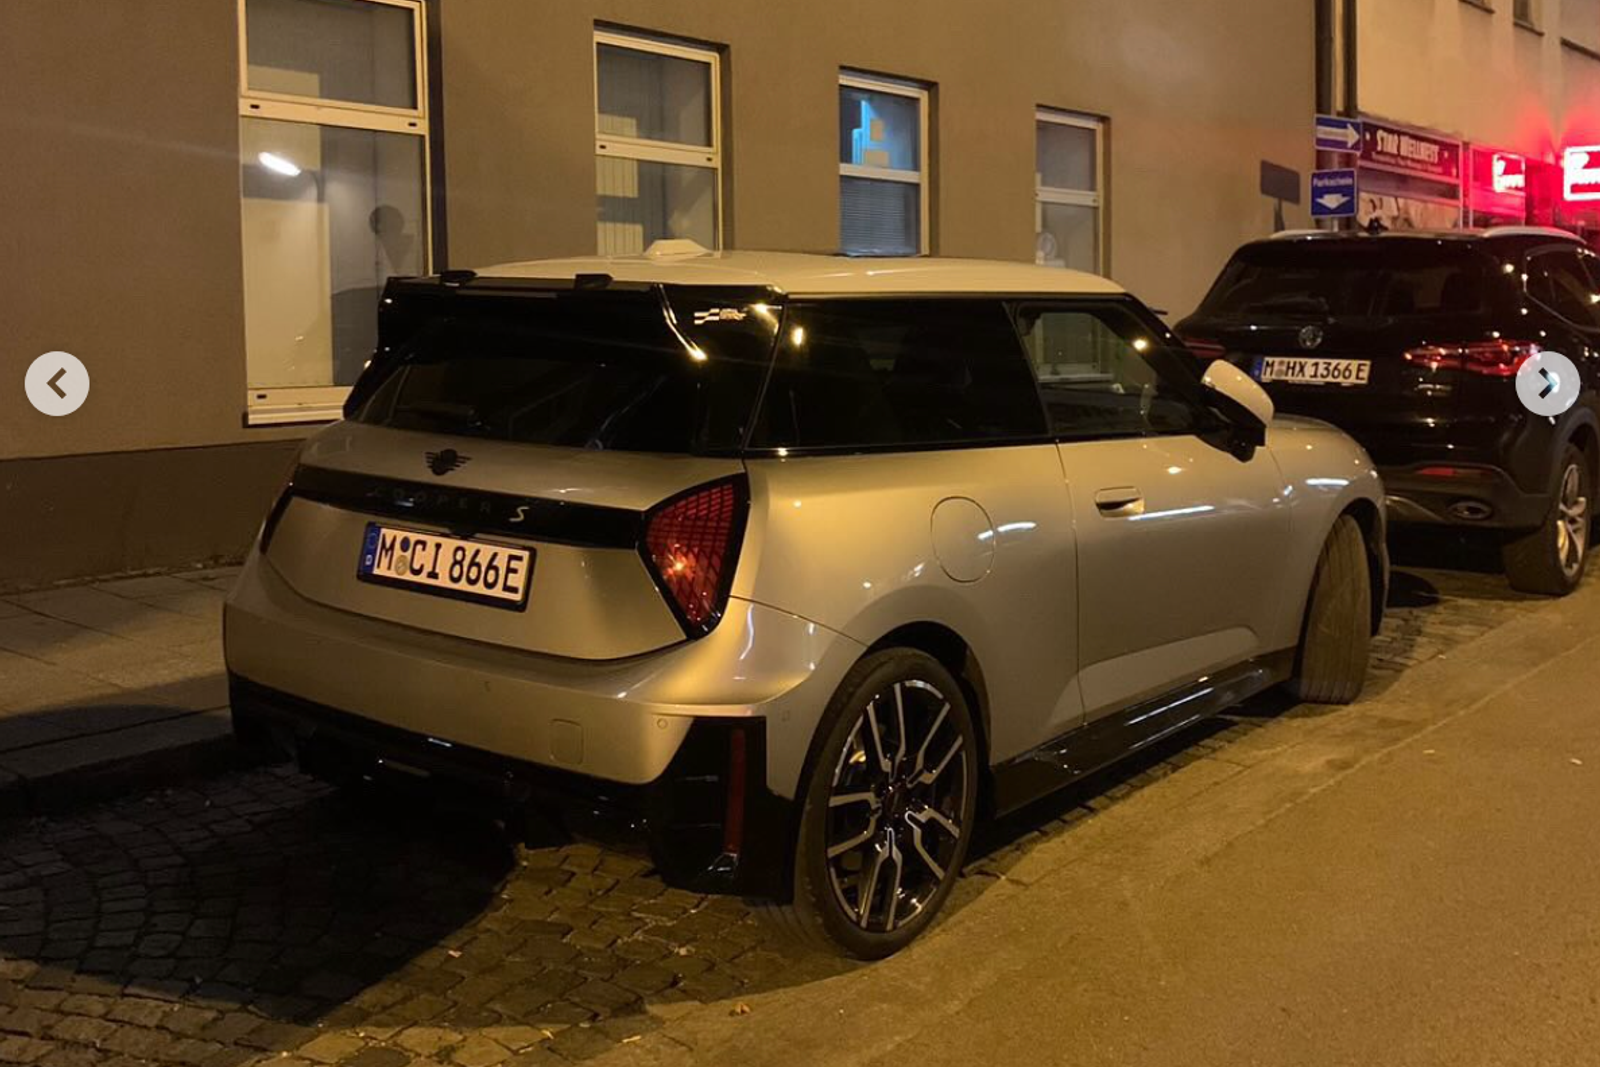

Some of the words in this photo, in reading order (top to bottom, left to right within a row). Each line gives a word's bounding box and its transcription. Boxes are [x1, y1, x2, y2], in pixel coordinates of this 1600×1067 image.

[1377, 129, 1398, 154] STAR
[1400, 135, 1439, 163] WELLNESS
[1313, 176, 1353, 187] Parkschein
[1264, 360, 1275, 377] M
[1285, 361, 1308, 378] HX
[375, 486, 491, 514] COOPER
[509, 506, 530, 522] S
[377, 533, 397, 571] M
[409, 539, 442, 580] CI
[449, 546, 523, 595] 866E
